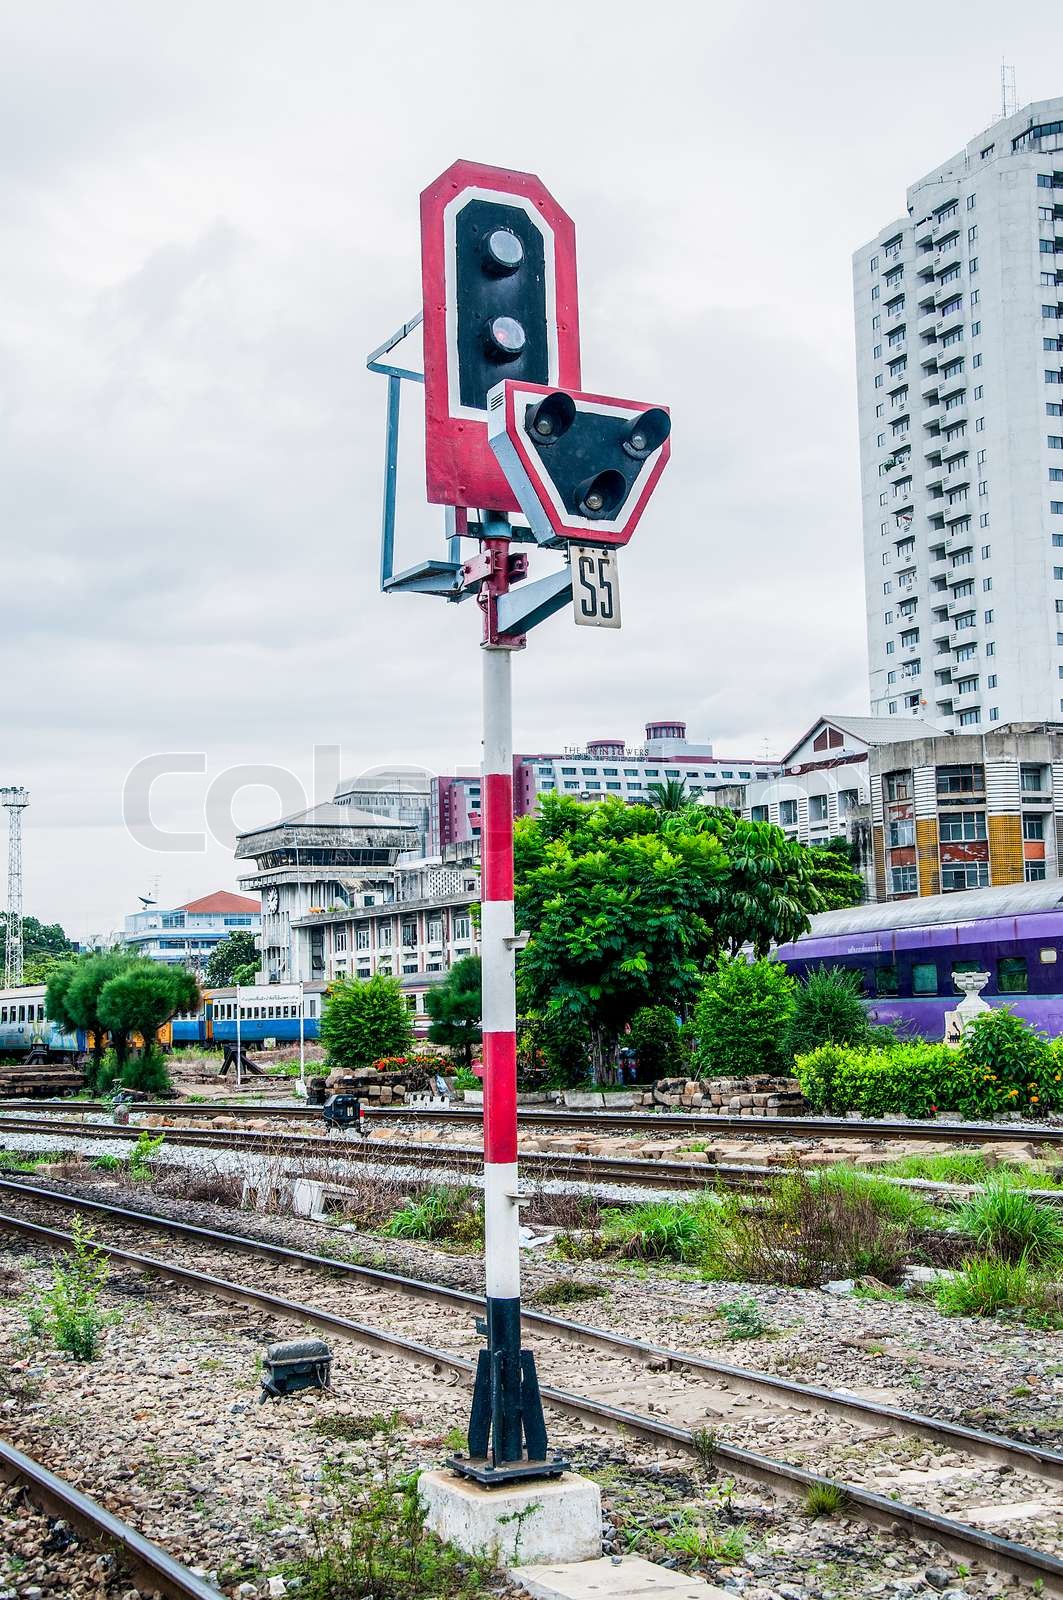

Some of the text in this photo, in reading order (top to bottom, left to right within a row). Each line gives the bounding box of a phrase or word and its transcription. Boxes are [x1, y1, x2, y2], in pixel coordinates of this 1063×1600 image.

[578, 555, 613, 619] S5
[563, 746, 580, 754] THE
[612, 747, 649, 757] TOWERS
